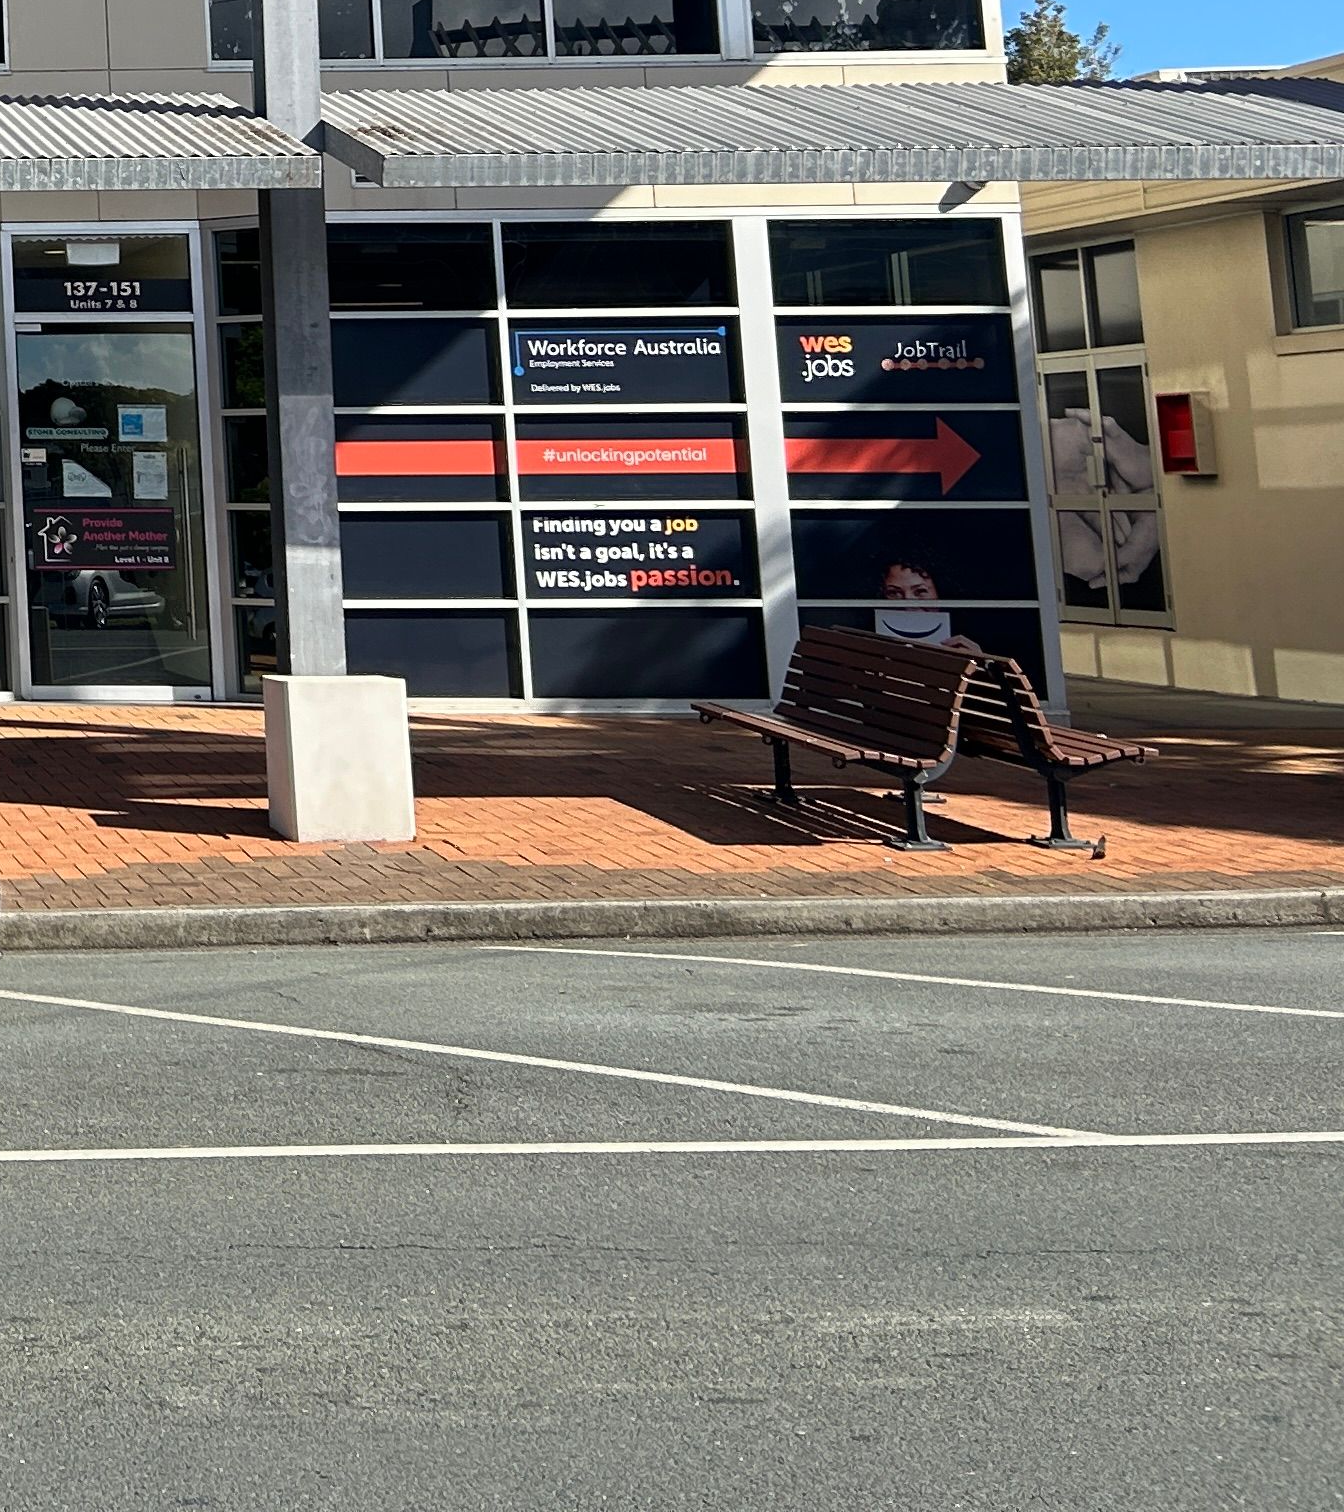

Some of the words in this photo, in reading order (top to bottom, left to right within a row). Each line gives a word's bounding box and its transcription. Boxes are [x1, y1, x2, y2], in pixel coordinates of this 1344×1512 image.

[63, 281, 141, 296] 137-151
[70, 299, 101, 309] Units
[104, 299, 112, 308] 7
[116, 299, 126, 308] &
[129, 299, 138, 308] 8
[527, 338, 627, 356] Workforce
[633, 337, 721, 355] Australia
[799, 336, 853, 354] wes
[894, 339, 967, 359] JobTrail
[529, 359, 580, 368] Employment
[581, 358, 615, 368] Services
[530, 383, 569, 392] Delivered
[570, 383, 581, 393] by
[80, 442, 109, 453] Please
[542, 447, 707, 467] #unlockingpotential
[82, 518, 124, 528] Provide
[532, 516, 606, 536] Finding
[608, 519, 646, 536] you
[650, 519, 662, 532] a
[663, 516, 699, 535] job
[83, 531, 127, 541] Another
[128, 530, 169, 541] Mother
[534, 544, 576, 561] isn't
[579, 548, 592, 560] a
[595, 543, 645, 563] goal,
[648, 542, 678, 560] it's
[681, 547, 694, 560] a
[630, 565, 740, 592] passion.
